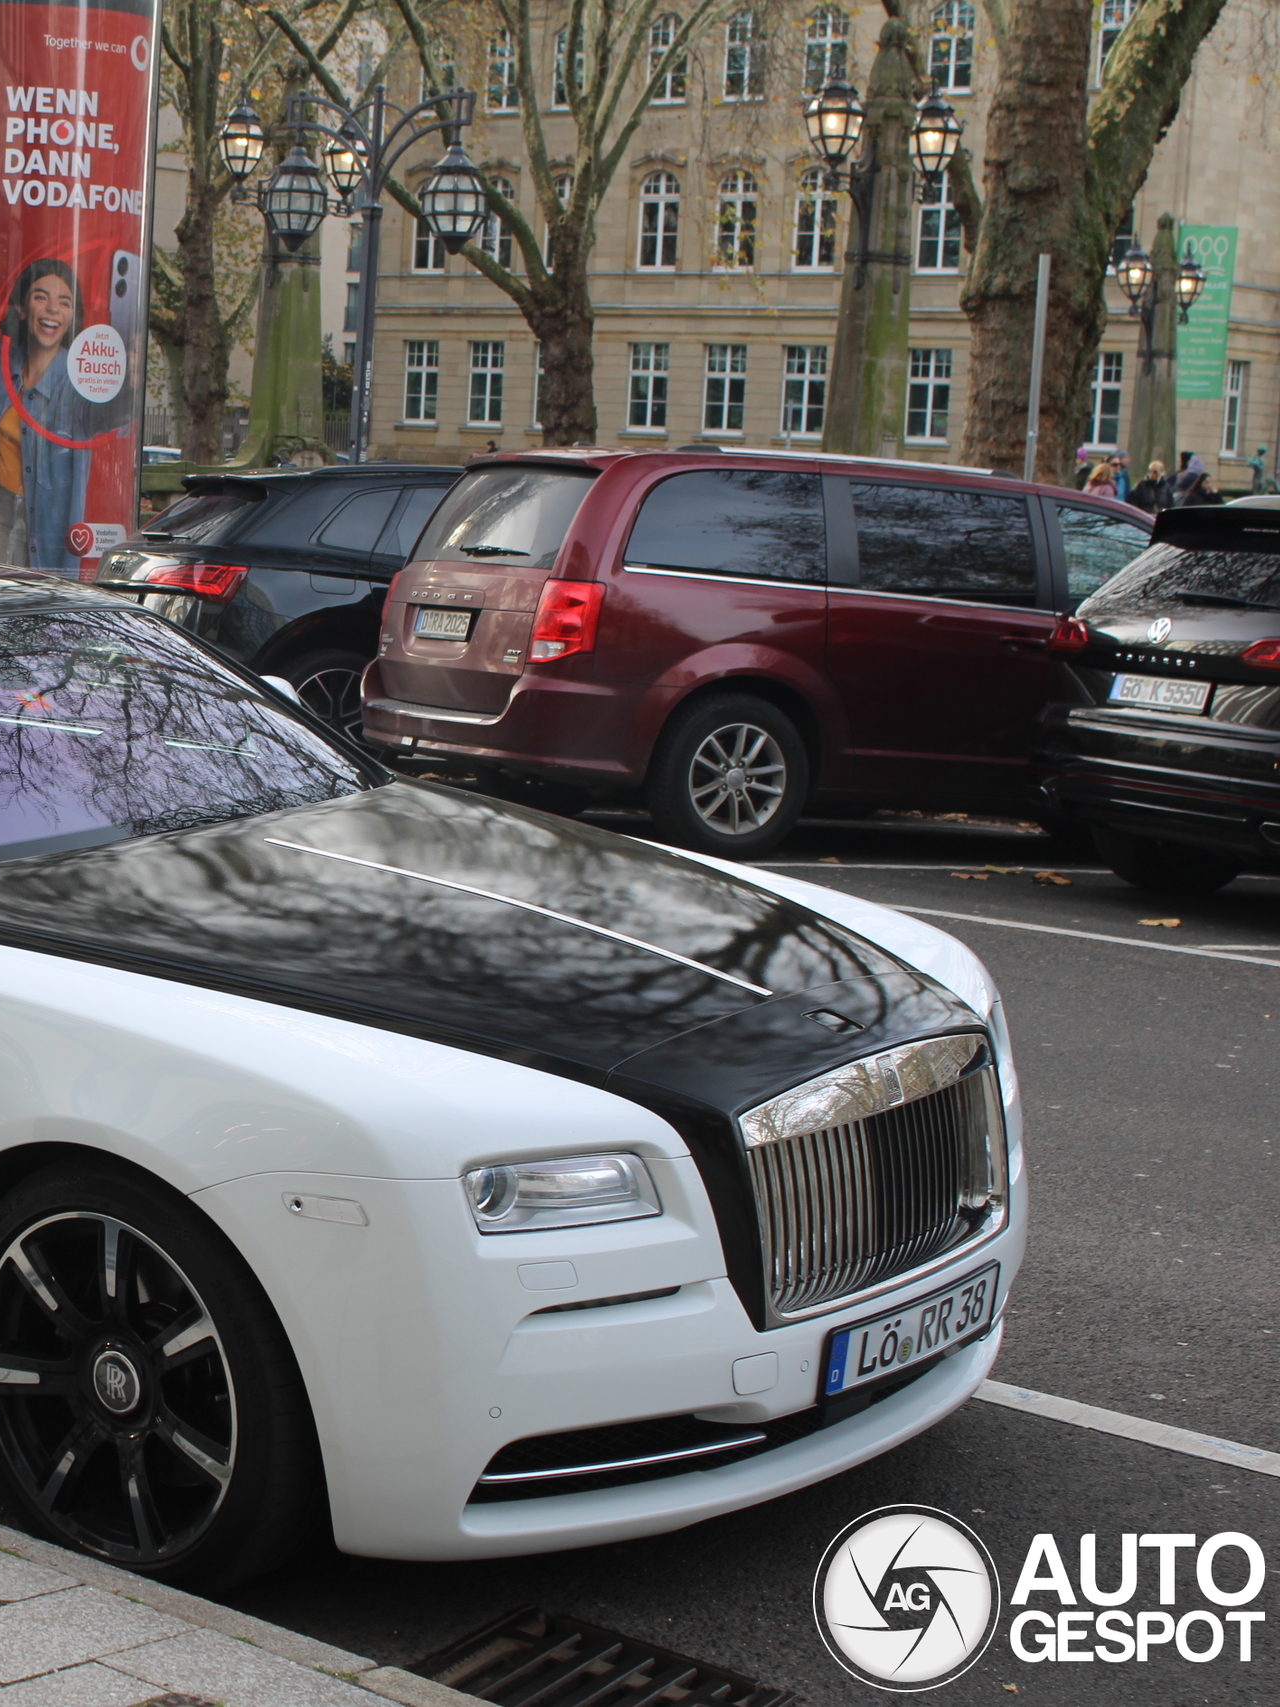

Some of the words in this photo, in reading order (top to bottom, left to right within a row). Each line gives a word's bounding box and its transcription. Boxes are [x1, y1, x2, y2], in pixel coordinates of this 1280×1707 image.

[43, 34, 92, 50] Together
[95, 42, 109, 51] we
[111, 44, 127, 54] can
[5, 86, 98, 117] WENN
[5, 117, 120, 155] PHONE,
[4, 148, 91, 178] DANN
[2, 179, 143, 216] VODAFONE
[95, 332, 109, 340] Jetzt
[80, 340, 119, 357] Akku-
[76, 358, 121, 375] Tausch
[78, 377, 95, 385] gratis
[96, 377, 102, 385] in
[103, 377, 119, 385] vielen
[412, 591, 473, 601] DODGE
[421, 612, 429, 630] D
[431, 613, 444, 632] RA
[444, 613, 469, 634] 2025
[1120, 676, 1144, 699] GÖ
[1149, 680, 1164, 701] K
[1162, 681, 1208, 706] 5550
[857, 1319, 902, 1377] LÖ
[916, 1296, 954, 1354] RR
[956, 1279, 987, 1333] 38
[831, 1369, 839, 1383] D
